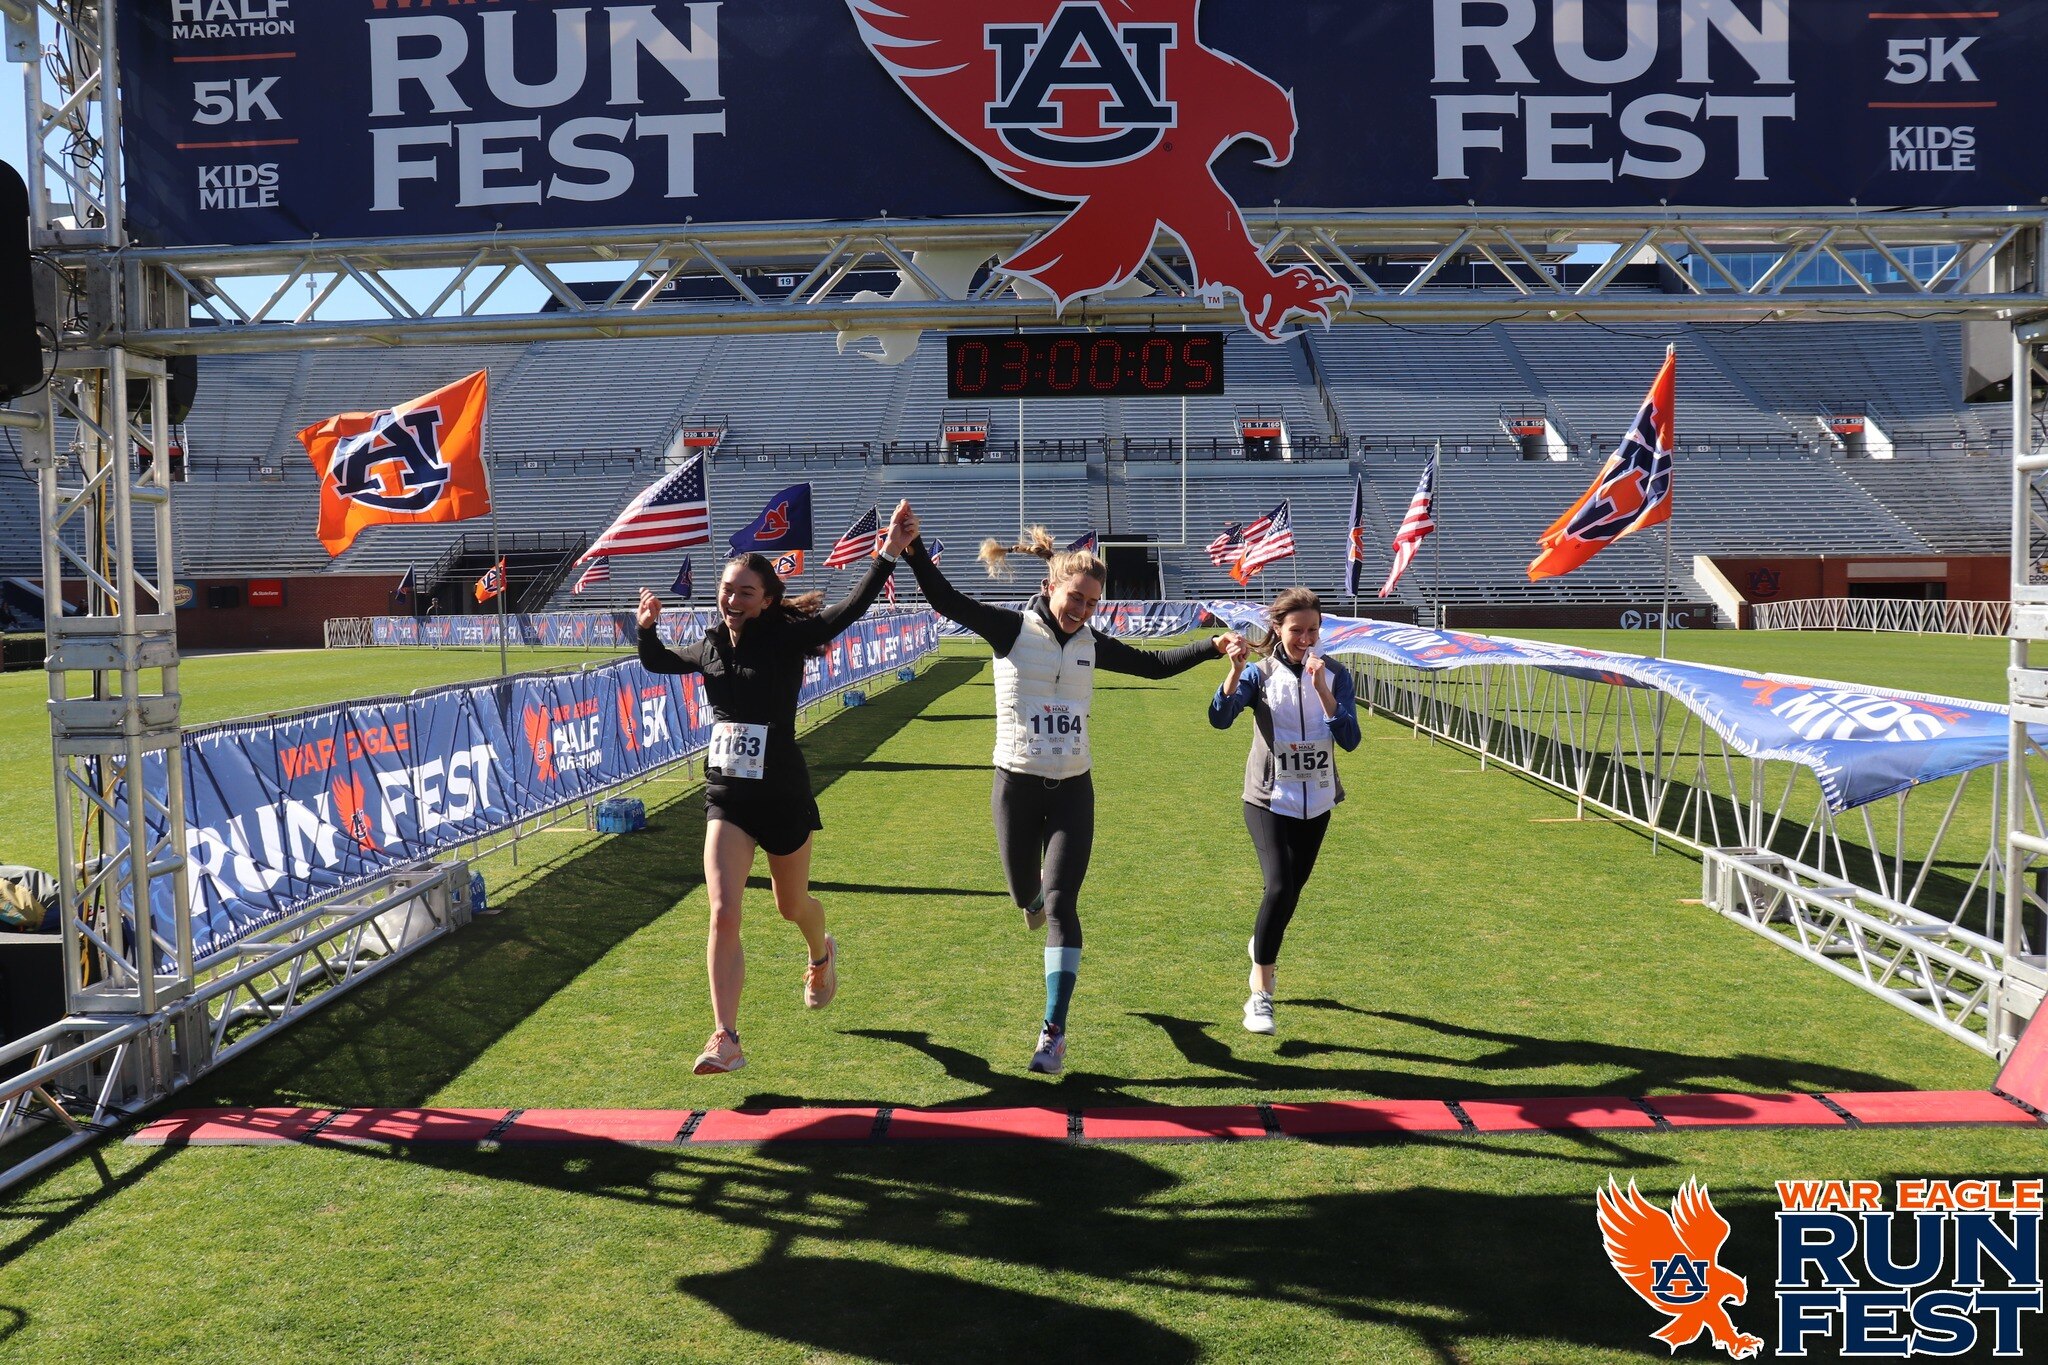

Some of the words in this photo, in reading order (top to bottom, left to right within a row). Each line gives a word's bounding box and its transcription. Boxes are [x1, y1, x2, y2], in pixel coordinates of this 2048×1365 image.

[171, 0, 290, 22] HALF
[172, 20, 295, 40] MARATHON
[1430, 0, 1795, 85] RUN
[365, 2, 726, 117] RUN
[1884, 36, 1981, 85] 5K
[192, 76, 283, 126] 5K
[1430, 92, 1796, 183] FEST
[1889, 126, 1976, 150] KIDS
[369, 109, 727, 212] FEST
[1890, 148, 1976, 172] MILE
[198, 163, 280, 190] KIDS
[199, 184, 280, 210] MILE
[780, 278, 791, 286] 19
[1207, 295, 1221, 305] TM
[955, 338, 1213, 392] 03:00:05
[1128, 615, 1182, 632] FEST
[1643, 612, 1690, 629] PNC
[641, 695, 670, 748] 5K
[1030, 714, 1082, 735] 1164
[280, 738, 337, 780] WAR
[715, 735, 761, 757] 1163
[1278, 750, 1329, 771] 1152
[187, 791, 340, 917] RUN
[376, 743, 499, 848] FEST
